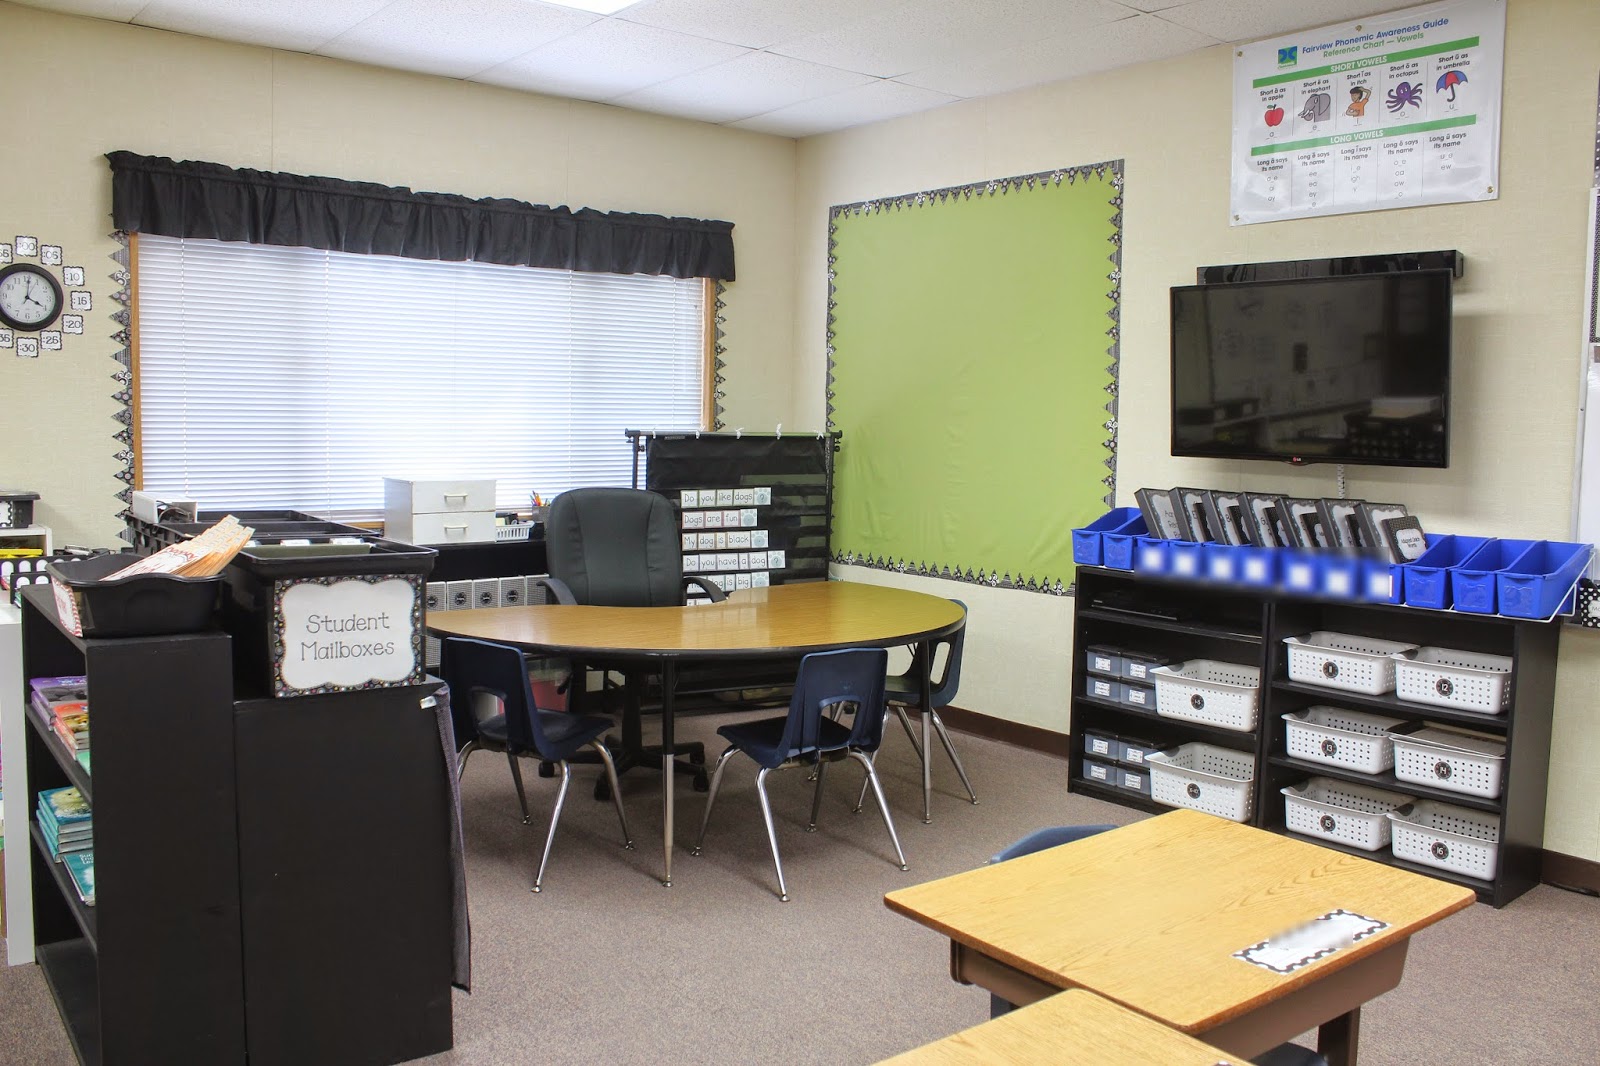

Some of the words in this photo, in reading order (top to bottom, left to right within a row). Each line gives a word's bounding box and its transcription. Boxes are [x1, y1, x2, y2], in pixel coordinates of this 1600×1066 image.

[1302, 41, 1334, 54] Fairview
[1335, 33, 1374, 48] Phonemic
[1376, 24, 1421, 39] Awareness
[1422, 18, 1449, 30] Guide
[1323, 44, 1361, 58] Reference
[1362, 39, 1385, 50] Chart
[1396, 32, 1424, 43] Vowels
[1330, 61, 1355, 73] SHORT
[1357, 55, 1388, 69] VOWELS
[1330, 134, 1352, 144] LONG
[1353, 129, 1384, 141] VOWELS
[684, 493, 695, 503] Do
[701, 495, 714, 504] you
[718, 491, 732, 501] like
[734, 493, 753, 503] dogs
[684, 514, 703, 526] Dogs
[706, 515, 720, 523] are
[725, 513, 738, 522] fun
[684, 536, 696, 548] My
[699, 536, 714, 548] dog
[728, 535, 749, 544] black
[686, 557, 696, 567] Do
[701, 558, 715, 568] you
[718, 556, 737, 566] have
[741, 557, 747, 565] a
[751, 555, 766, 567] dog
[726, 577, 733, 586] is
[738, 576, 749, 589] big
[306, 612, 390, 634] Student
[300, 641, 395, 662] Mailboxes
[1441, 683, 1449, 692] 12
[1436, 846, 1444, 855] 16
